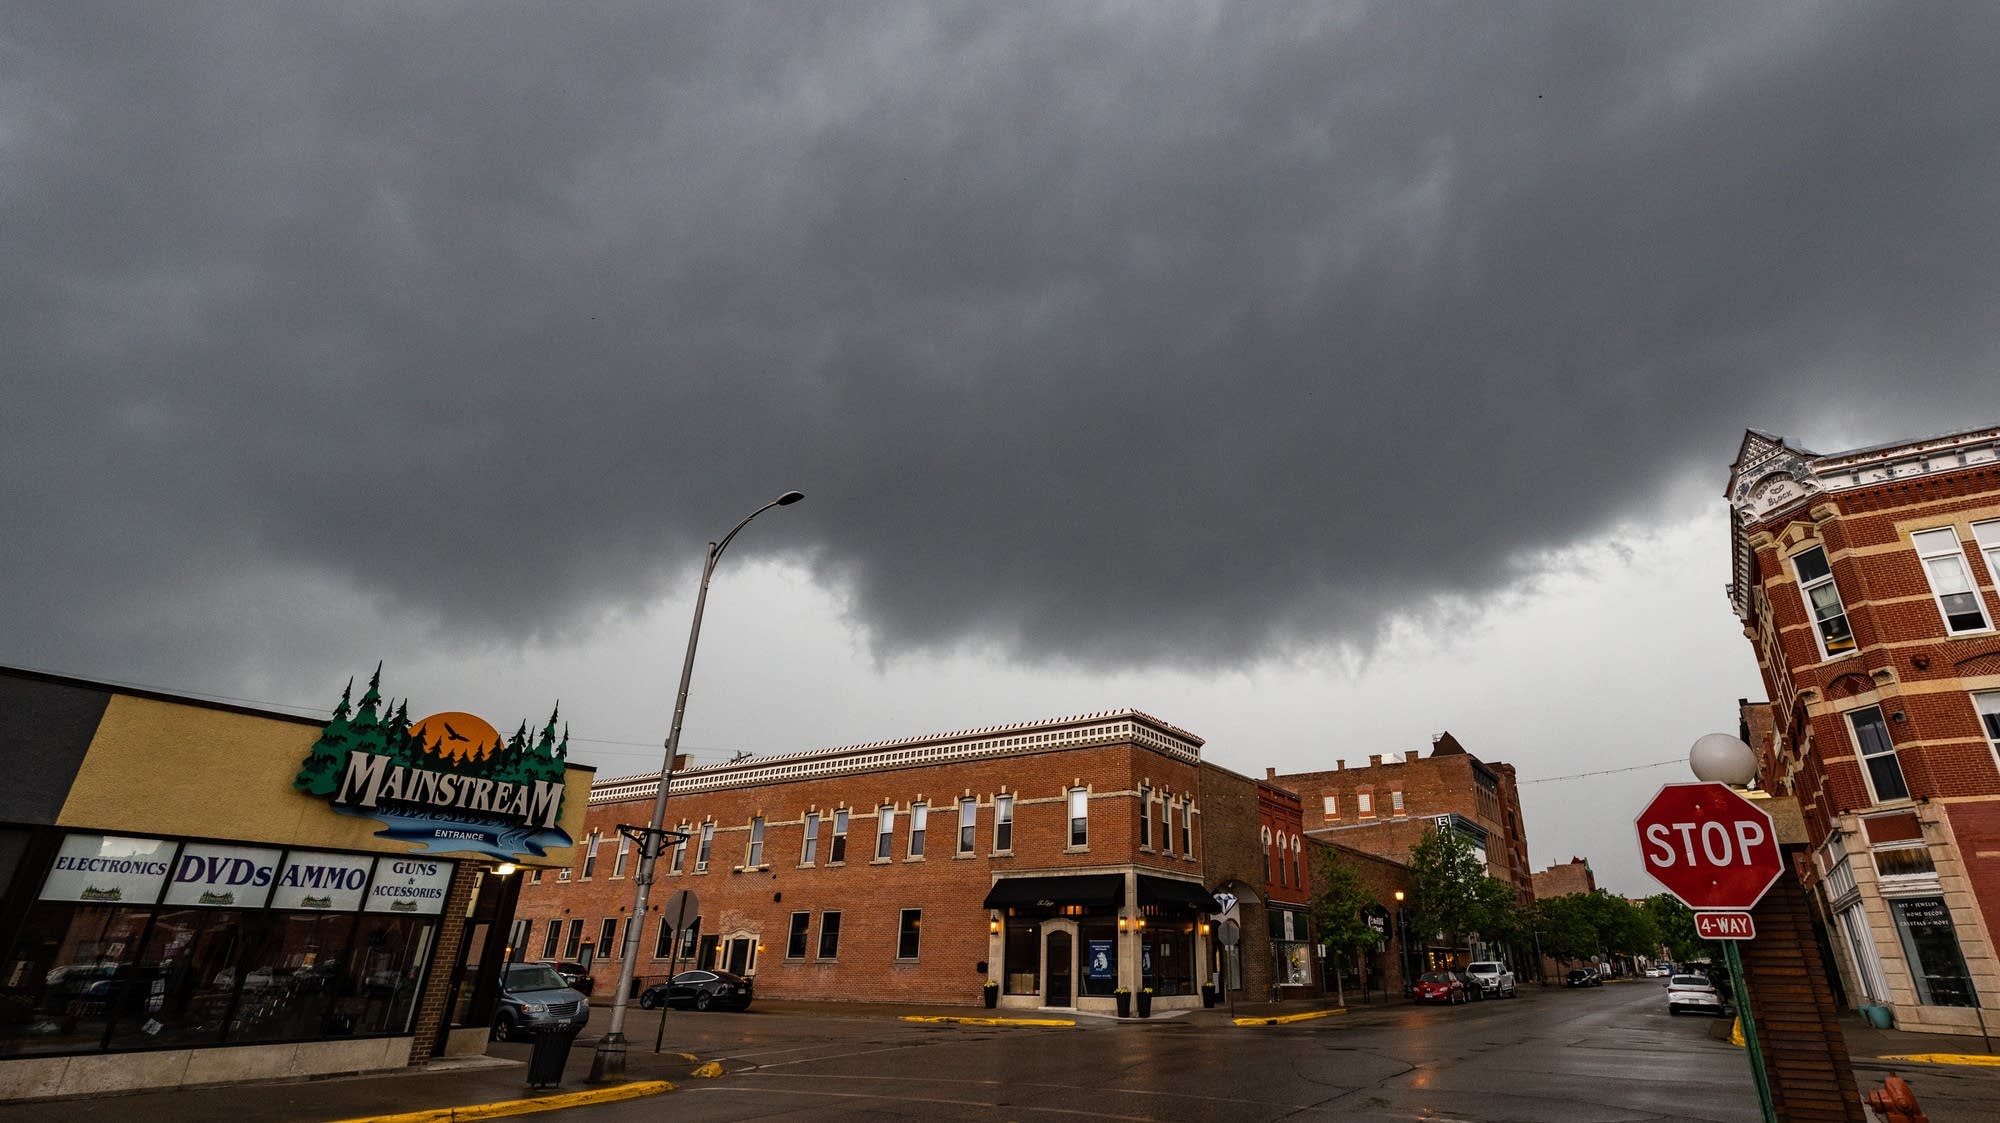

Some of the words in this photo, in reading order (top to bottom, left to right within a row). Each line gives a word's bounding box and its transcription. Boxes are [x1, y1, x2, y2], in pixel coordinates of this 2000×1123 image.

[1756, 485, 1768, 499] ODD
[1768, 490, 1792, 506] BLOCK
[335, 750, 565, 829] MAINSTREAM
[434, 829, 485, 842] ENTRANCE
[1646, 820, 1765, 868] STOP
[55, 856, 168, 876] ELECTRONICS
[173, 854, 273, 887] DVDs
[392, 861, 438, 876] GUNS
[278, 864, 367, 891] AMMO
[407, 877, 416, 886] &
[372, 885, 443, 899] ACCESSORIES
[1701, 917, 1748, 934] 4-WAY
